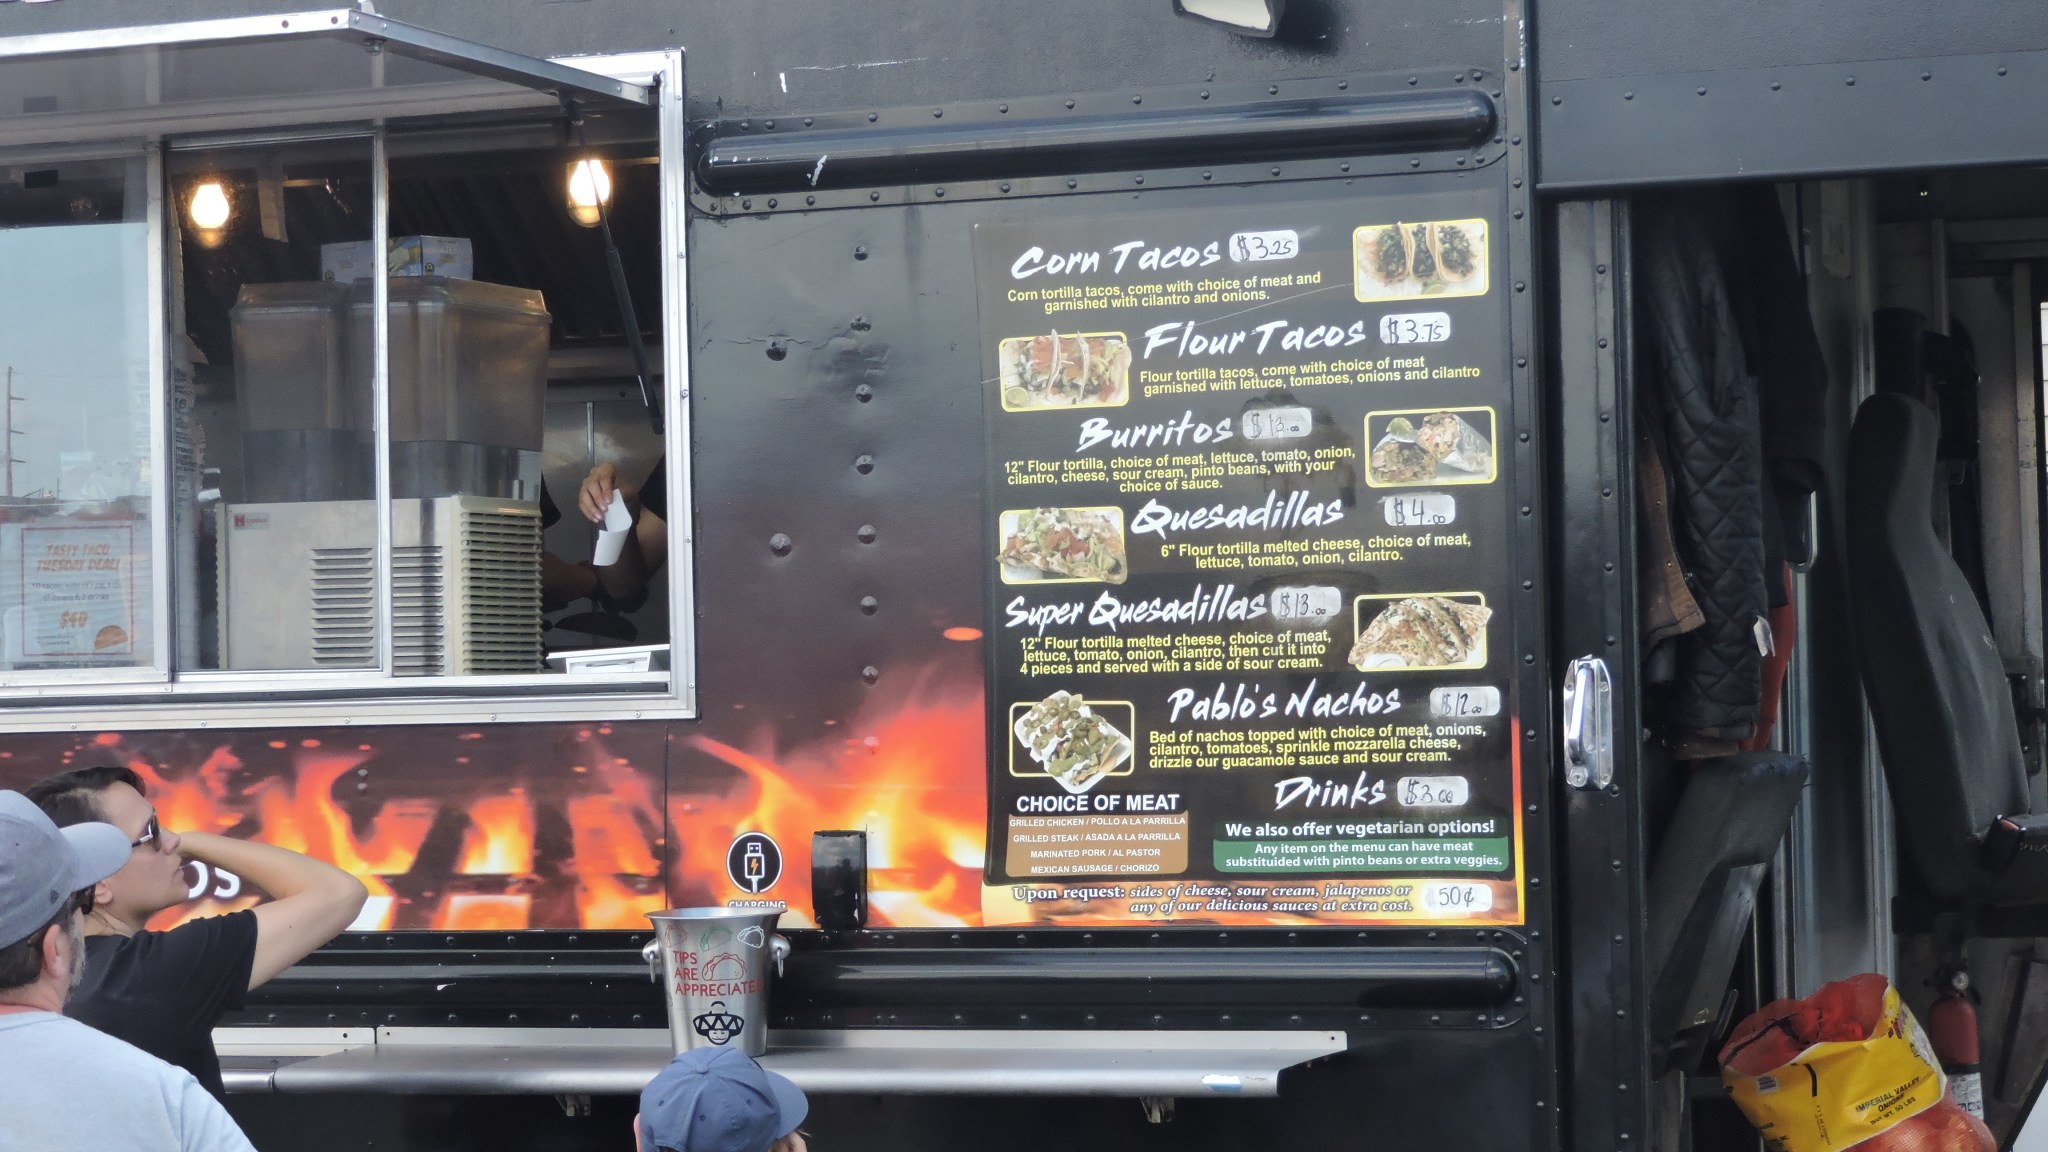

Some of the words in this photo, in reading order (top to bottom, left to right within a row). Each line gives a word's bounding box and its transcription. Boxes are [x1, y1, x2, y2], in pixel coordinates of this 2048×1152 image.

[1011, 246, 1100, 279] Corn
[1108, 241, 1221, 274] Tacos
[1008, 290, 1037, 301] Corn
[1041, 286, 1081, 299] tortilla
[1085, 286, 1123, 299] tacos,
[1128, 284, 1162, 294] come
[1166, 280, 1192, 292] with
[1197, 278, 1239, 290] choice
[1244, 276, 1257, 288] of
[1261, 274, 1292, 287] meat
[1296, 272, 1320, 284] and
[1044, 297, 1107, 314] garnished
[1110, 295, 1137, 307] with
[1141, 294, 1190, 306] cilantro
[1193, 290, 1217, 303] and
[1221, 289, 1269, 301] onions.
[1143, 321, 1244, 360] Flour
[1250, 320, 1366, 355] Tacos
[1140, 371, 1172, 382] Flour
[1175, 368, 1216, 380] tortilla
[1219, 368, 1257, 380] tacos,
[1261, 365, 1296, 376] come
[1299, 361, 1326, 373] with
[1330, 359, 1372, 371] choice
[1376, 358, 1389, 369] of
[1393, 356, 1424, 368] meat
[1075, 410, 1234, 453] Burritos
[1131, 489, 1344, 540] Quesadillas
[1179, 544, 1214, 557] Flour
[1216, 542, 1259, 554] tortilla
[1263, 540, 1308, 552] melted
[1312, 539, 1363, 554] cheese,
[1368, 537, 1413, 550] choice
[1416, 536, 1430, 546] of
[1434, 534, 1470, 546] meat,
[1005, 595, 1083, 636] Super
[1089, 583, 1268, 632] Quesadillas
[1044, 637, 1078, 648] Flour
[1081, 635, 1123, 648] tortilla
[1127, 634, 1171, 647] melted
[1174, 634, 1225, 648] cheese,
[1229, 632, 1273, 644] choice
[1277, 631, 1291, 644] of
[1294, 630, 1331, 645] meat,
[1167, 682, 1277, 723] Pablo's
[1284, 678, 1401, 718] Nachos
[1149, 730, 1175, 743] Bed
[1179, 730, 1193, 742] of
[1196, 729, 1244, 741] nachos
[1247, 728, 1294, 743] topped
[1298, 727, 1326, 739] with
[1330, 725, 1375, 738] choice
[1378, 724, 1392, 737] of
[1395, 724, 1432, 739] meat,
[1436, 723, 1486, 736] onions,
[1149, 755, 1192, 768] drizzle
[1195, 758, 1219, 767] our
[1222, 752, 1295, 769] guacamole
[1298, 754, 1339, 764] sauce
[1342, 750, 1368, 763] and
[1371, 752, 1402, 762] sour
[1405, 752, 1451, 761] cream.
[1274, 770, 1386, 811] Drinks
[1016, 795, 1088, 812] CHOICE
[1093, 794, 1120, 810] OF
[1126, 794, 1179, 810] MEAT
[1009, 817, 1044, 826] GRILLED
[1046, 817, 1084, 826] CHICKEN
[1091, 816, 1120, 824] POLLO
[1143, 816, 1185, 824] PARRILLA
[1225, 823, 1251, 836] We
[1255, 822, 1288, 836] also
[1292, 822, 1332, 835] offer
[1335, 820, 1424, 837] vegetarian
[1428, 819, 1494, 836] options!
[1013, 834, 1048, 842] GRILLED
[1050, 834, 1078, 842] STEAK
[1255, 843, 1278, 855] Any
[1280, 843, 1307, 853] item
[1328, 842, 1348, 852] the
[1411, 840, 1440, 850] have
[1442, 842, 1473, 850] meat
[1126, 848, 1160, 856] PASTOR
[1225, 854, 1300, 866] substituided
[1302, 856, 1330, 865] with
[1332, 855, 1364, 867] pinto
[1367, 855, 1402, 864] beans
[1420, 856, 1451, 864] extra
[1453, 855, 1502, 867] veggies.
[1072, 864, 1113, 872] SAUSAGE
[1014, 884, 1058, 903] Upon
[1063, 886, 1125, 902] request:
[1130, 886, 1163, 897] sides
[1167, 885, 1183, 899] of
[1184, 884, 1232, 900] cheese,
[1236, 888, 1268, 896] sour
[1272, 888, 1319, 897] cream,
[1325, 884, 1391, 899] jalapenos
[1396, 887, 1408, 895] or
[1130, 904, 1157, 918] any
[1160, 898, 1176, 914] of
[1177, 903, 1203, 911] our
[1205, 898, 1269, 911] delicious
[1271, 903, 1318, 911] sauces
[1322, 897, 1337, 911] at
[1340, 897, 1381, 911] extra
[1382, 901, 1412, 910] cost.
[673, 950, 698, 964] TIPS
[674, 968, 699, 980] ARE
[1855, 1092, 1894, 1113] IMPERIAL
